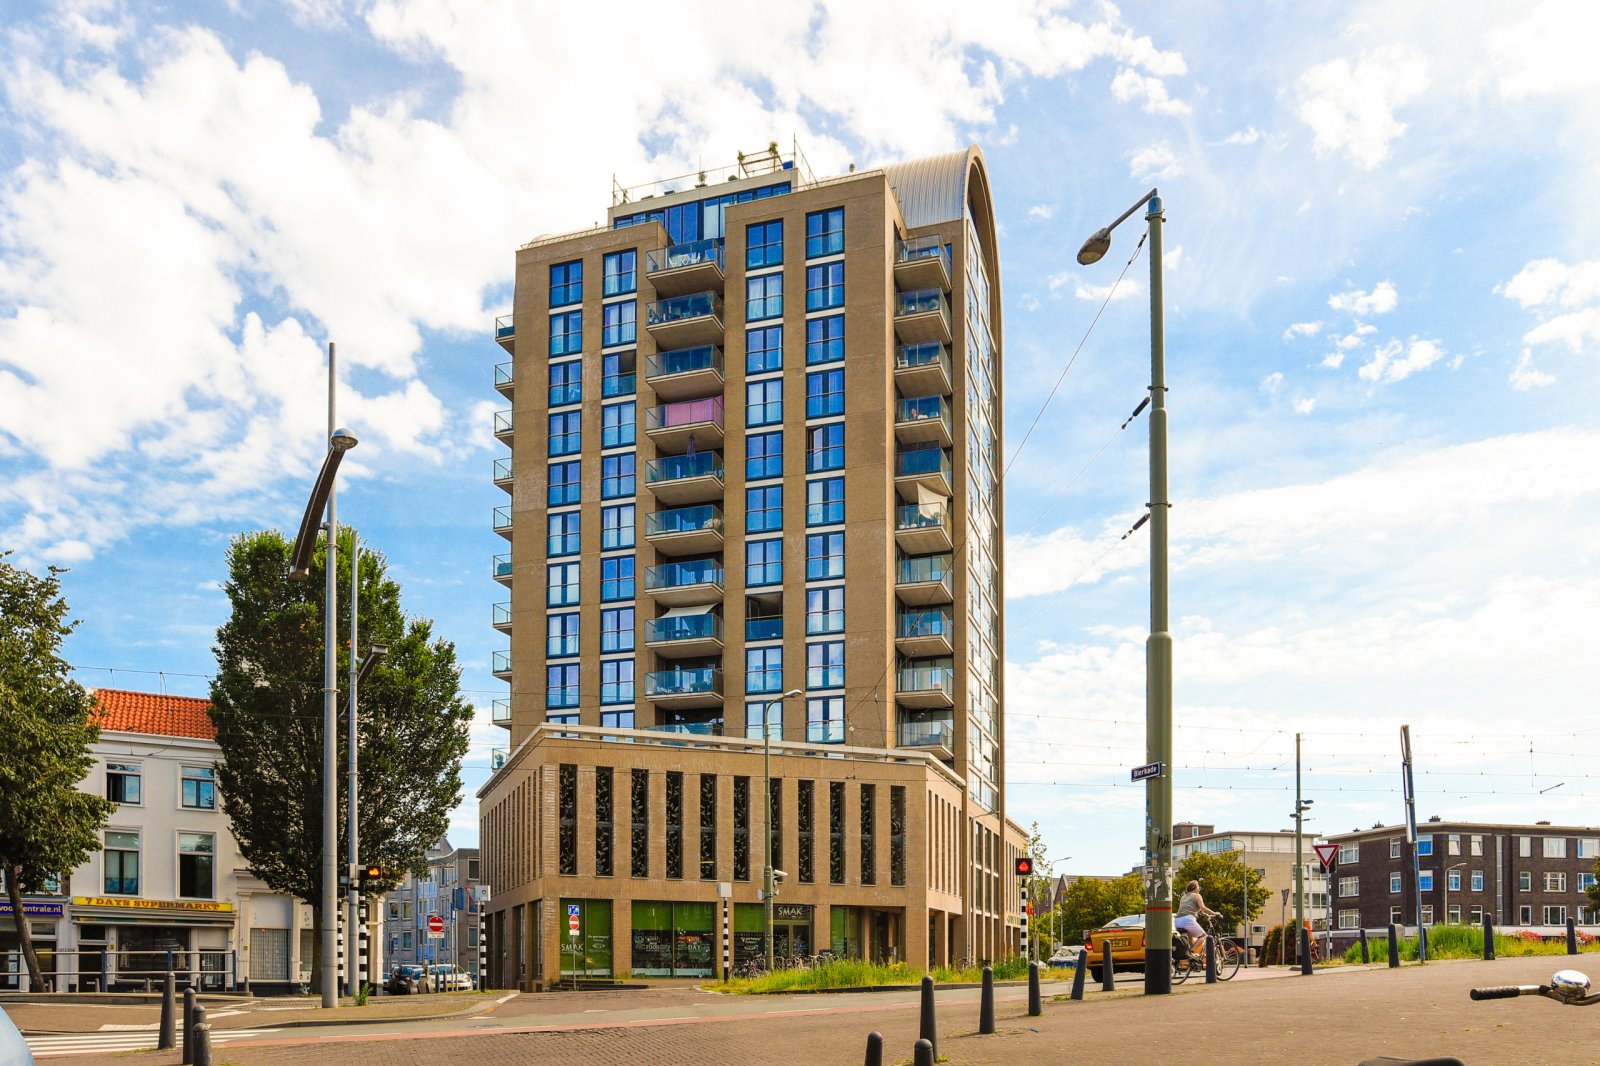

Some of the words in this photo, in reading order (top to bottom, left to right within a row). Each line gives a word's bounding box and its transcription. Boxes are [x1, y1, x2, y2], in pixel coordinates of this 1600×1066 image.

[1133, 765, 1157, 778] Bierkade
[85, 897, 92, 905] 7
[96, 898, 130, 907] DAYS
[134, 900, 220, 911] SUPERMARKT
[778, 906, 803, 916] SMAK
